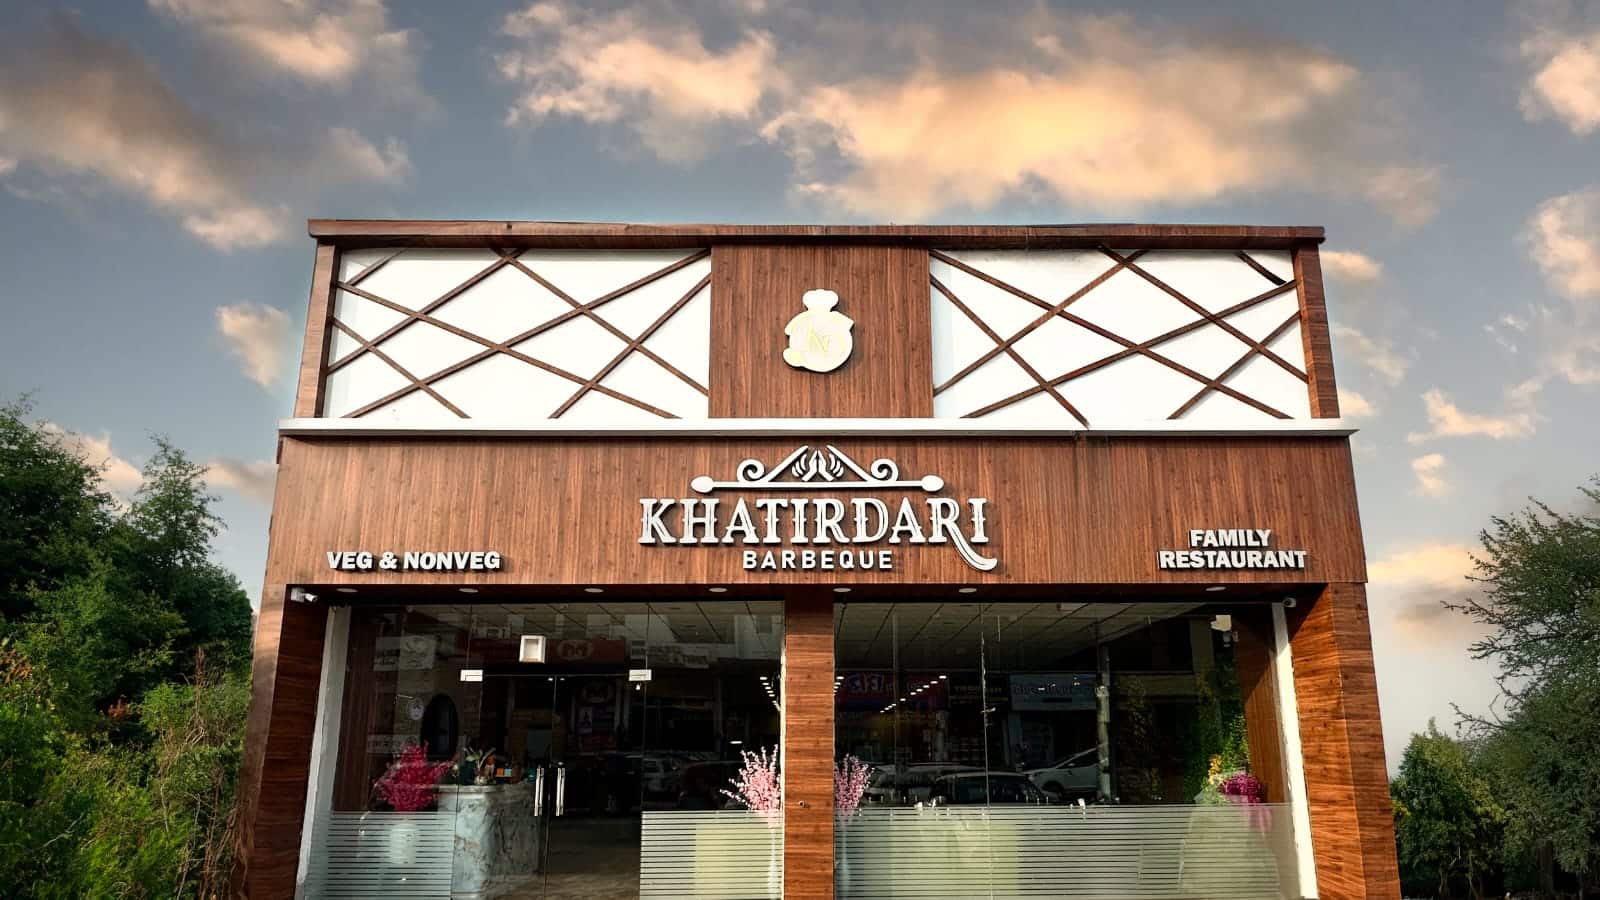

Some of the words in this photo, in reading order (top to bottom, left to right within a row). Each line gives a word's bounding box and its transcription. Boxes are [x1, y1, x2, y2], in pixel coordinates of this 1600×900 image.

[638, 497, 998, 571] KHATIRDARI
[1189, 528, 1272, 547] FAMILY
[327, 551, 373, 569] VEG
[379, 551, 398, 569] &
[403, 551, 501, 569] NONVEG
[743, 550, 893, 569] BARBEQUE
[1159, 550, 1307, 569] RESTAURANT
